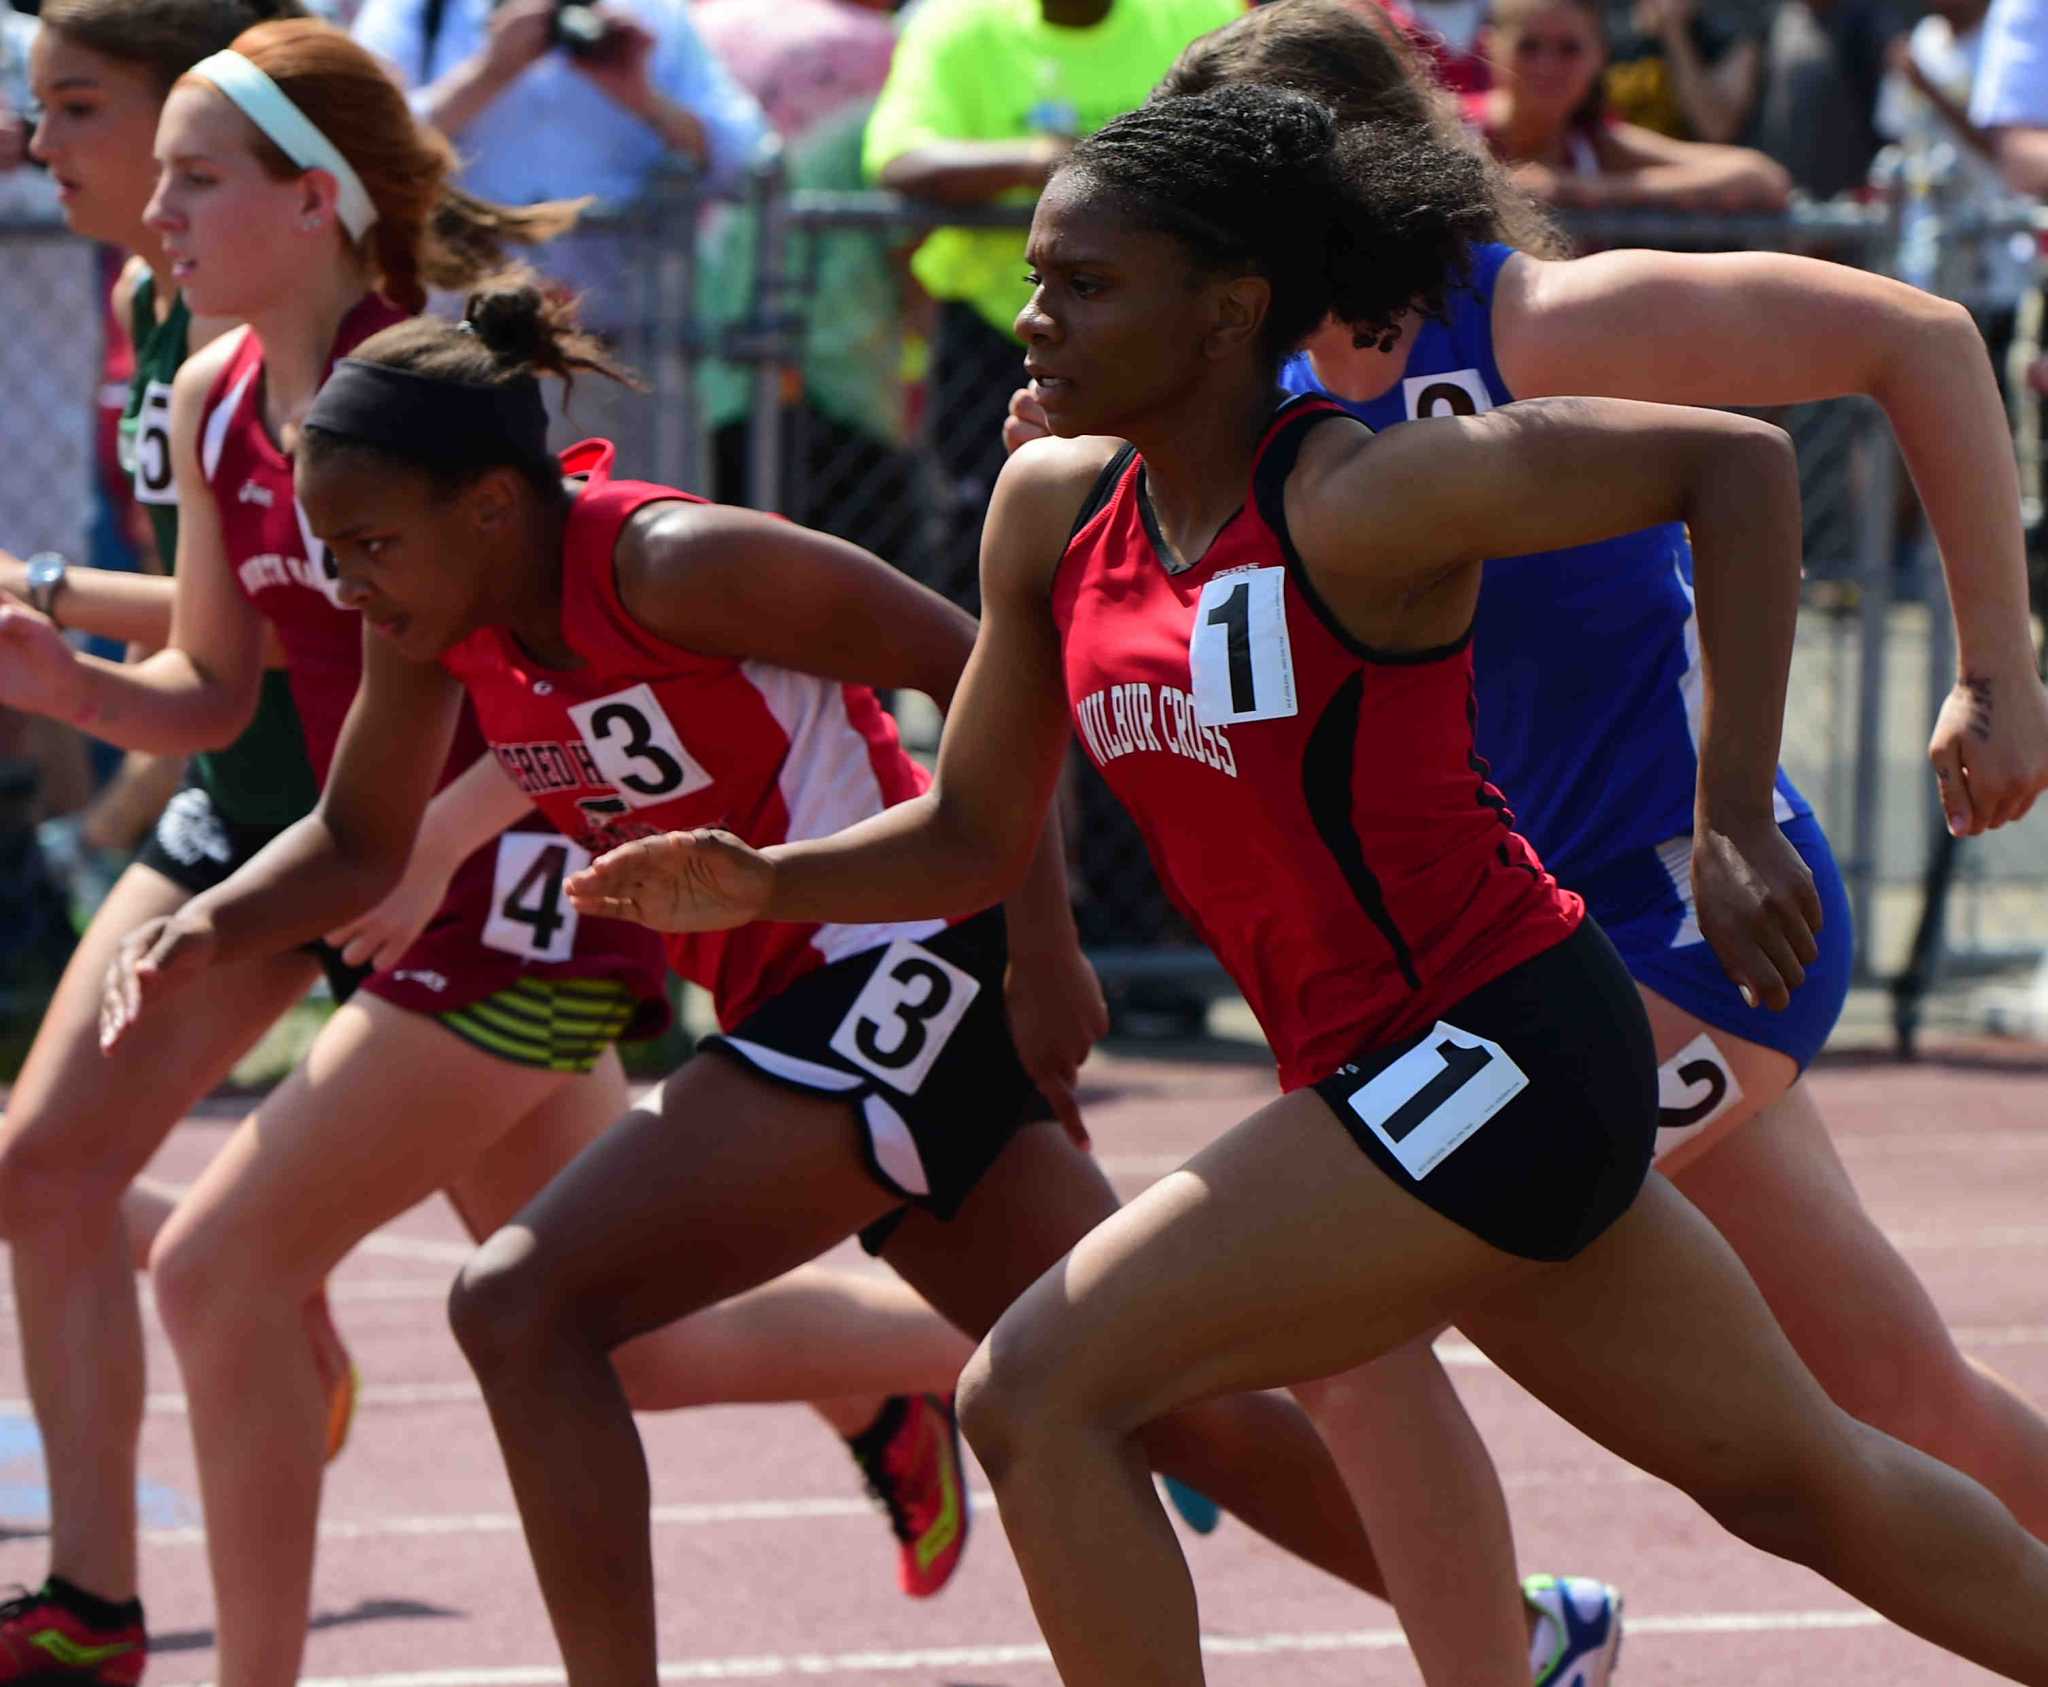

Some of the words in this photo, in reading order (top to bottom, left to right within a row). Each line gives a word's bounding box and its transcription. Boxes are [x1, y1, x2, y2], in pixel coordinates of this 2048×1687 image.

[1207, 582, 1257, 714] 1
[590, 703, 684, 795] 3
[1076, 682, 1162, 767] WILBUR
[1159, 685, 1238, 778] CROSS
[502, 845, 569, 951] 4
[854, 957, 953, 1069] 3
[1381, 1039, 1495, 1144] 1
